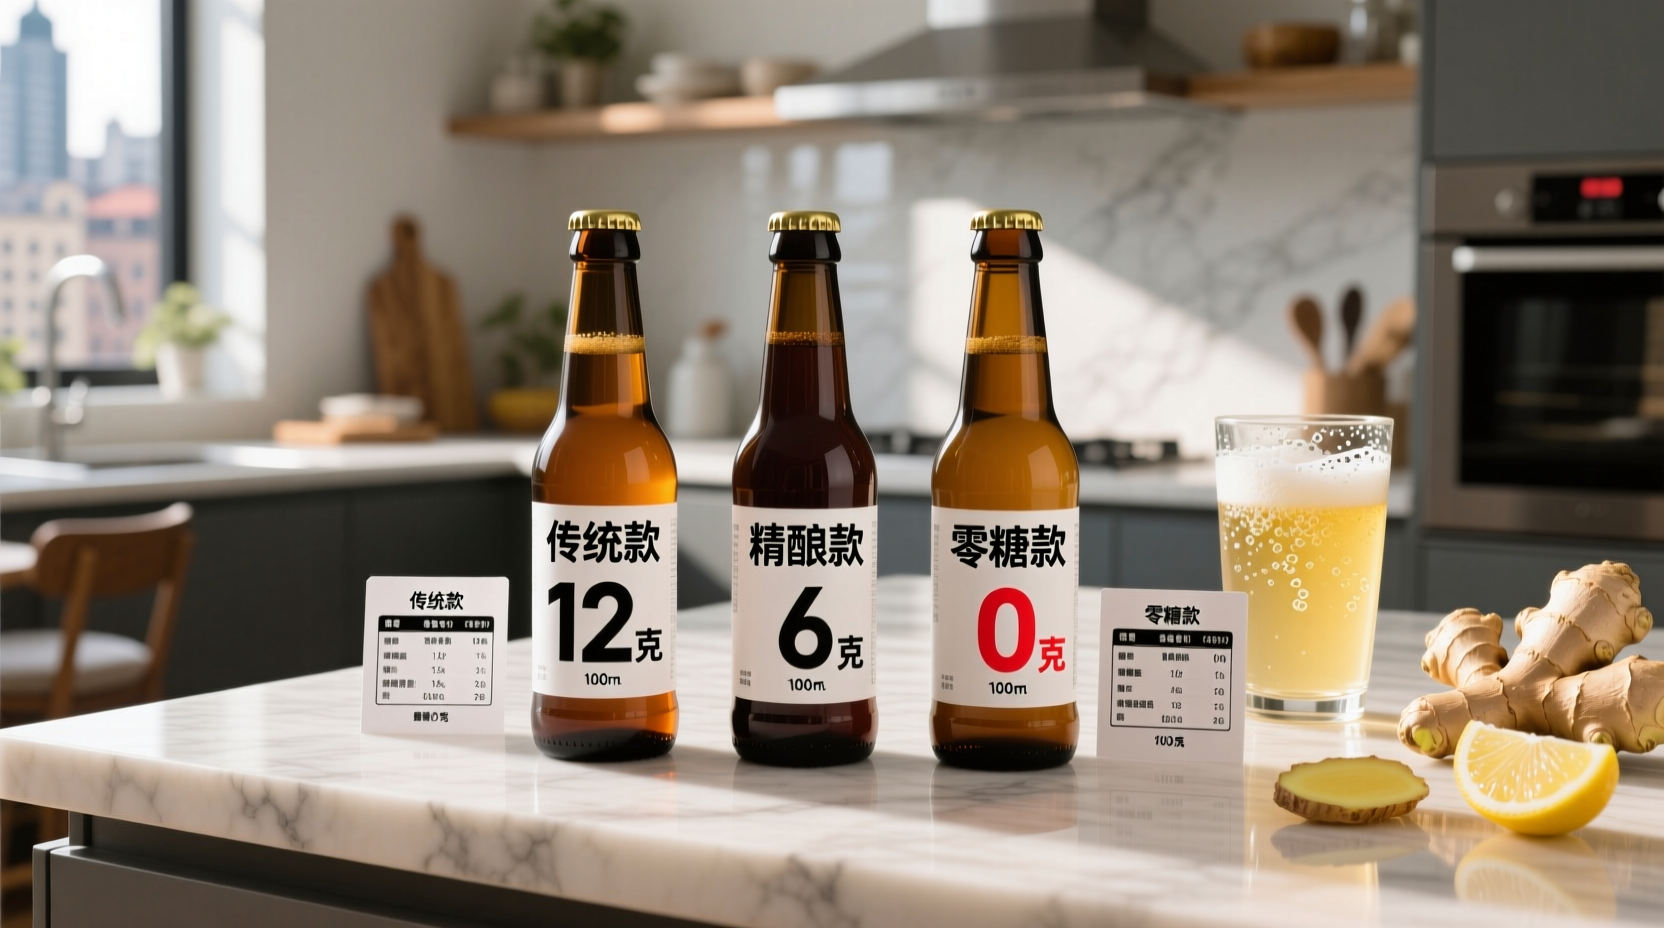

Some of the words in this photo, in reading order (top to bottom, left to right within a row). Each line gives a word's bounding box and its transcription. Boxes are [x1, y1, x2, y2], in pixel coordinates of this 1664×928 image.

[547, 520, 660, 563] 传统款
[749, 522, 864, 567] 精酿款
[950, 524, 1066, 569] 零糖款
[410, 591, 464, 610] 传统款
